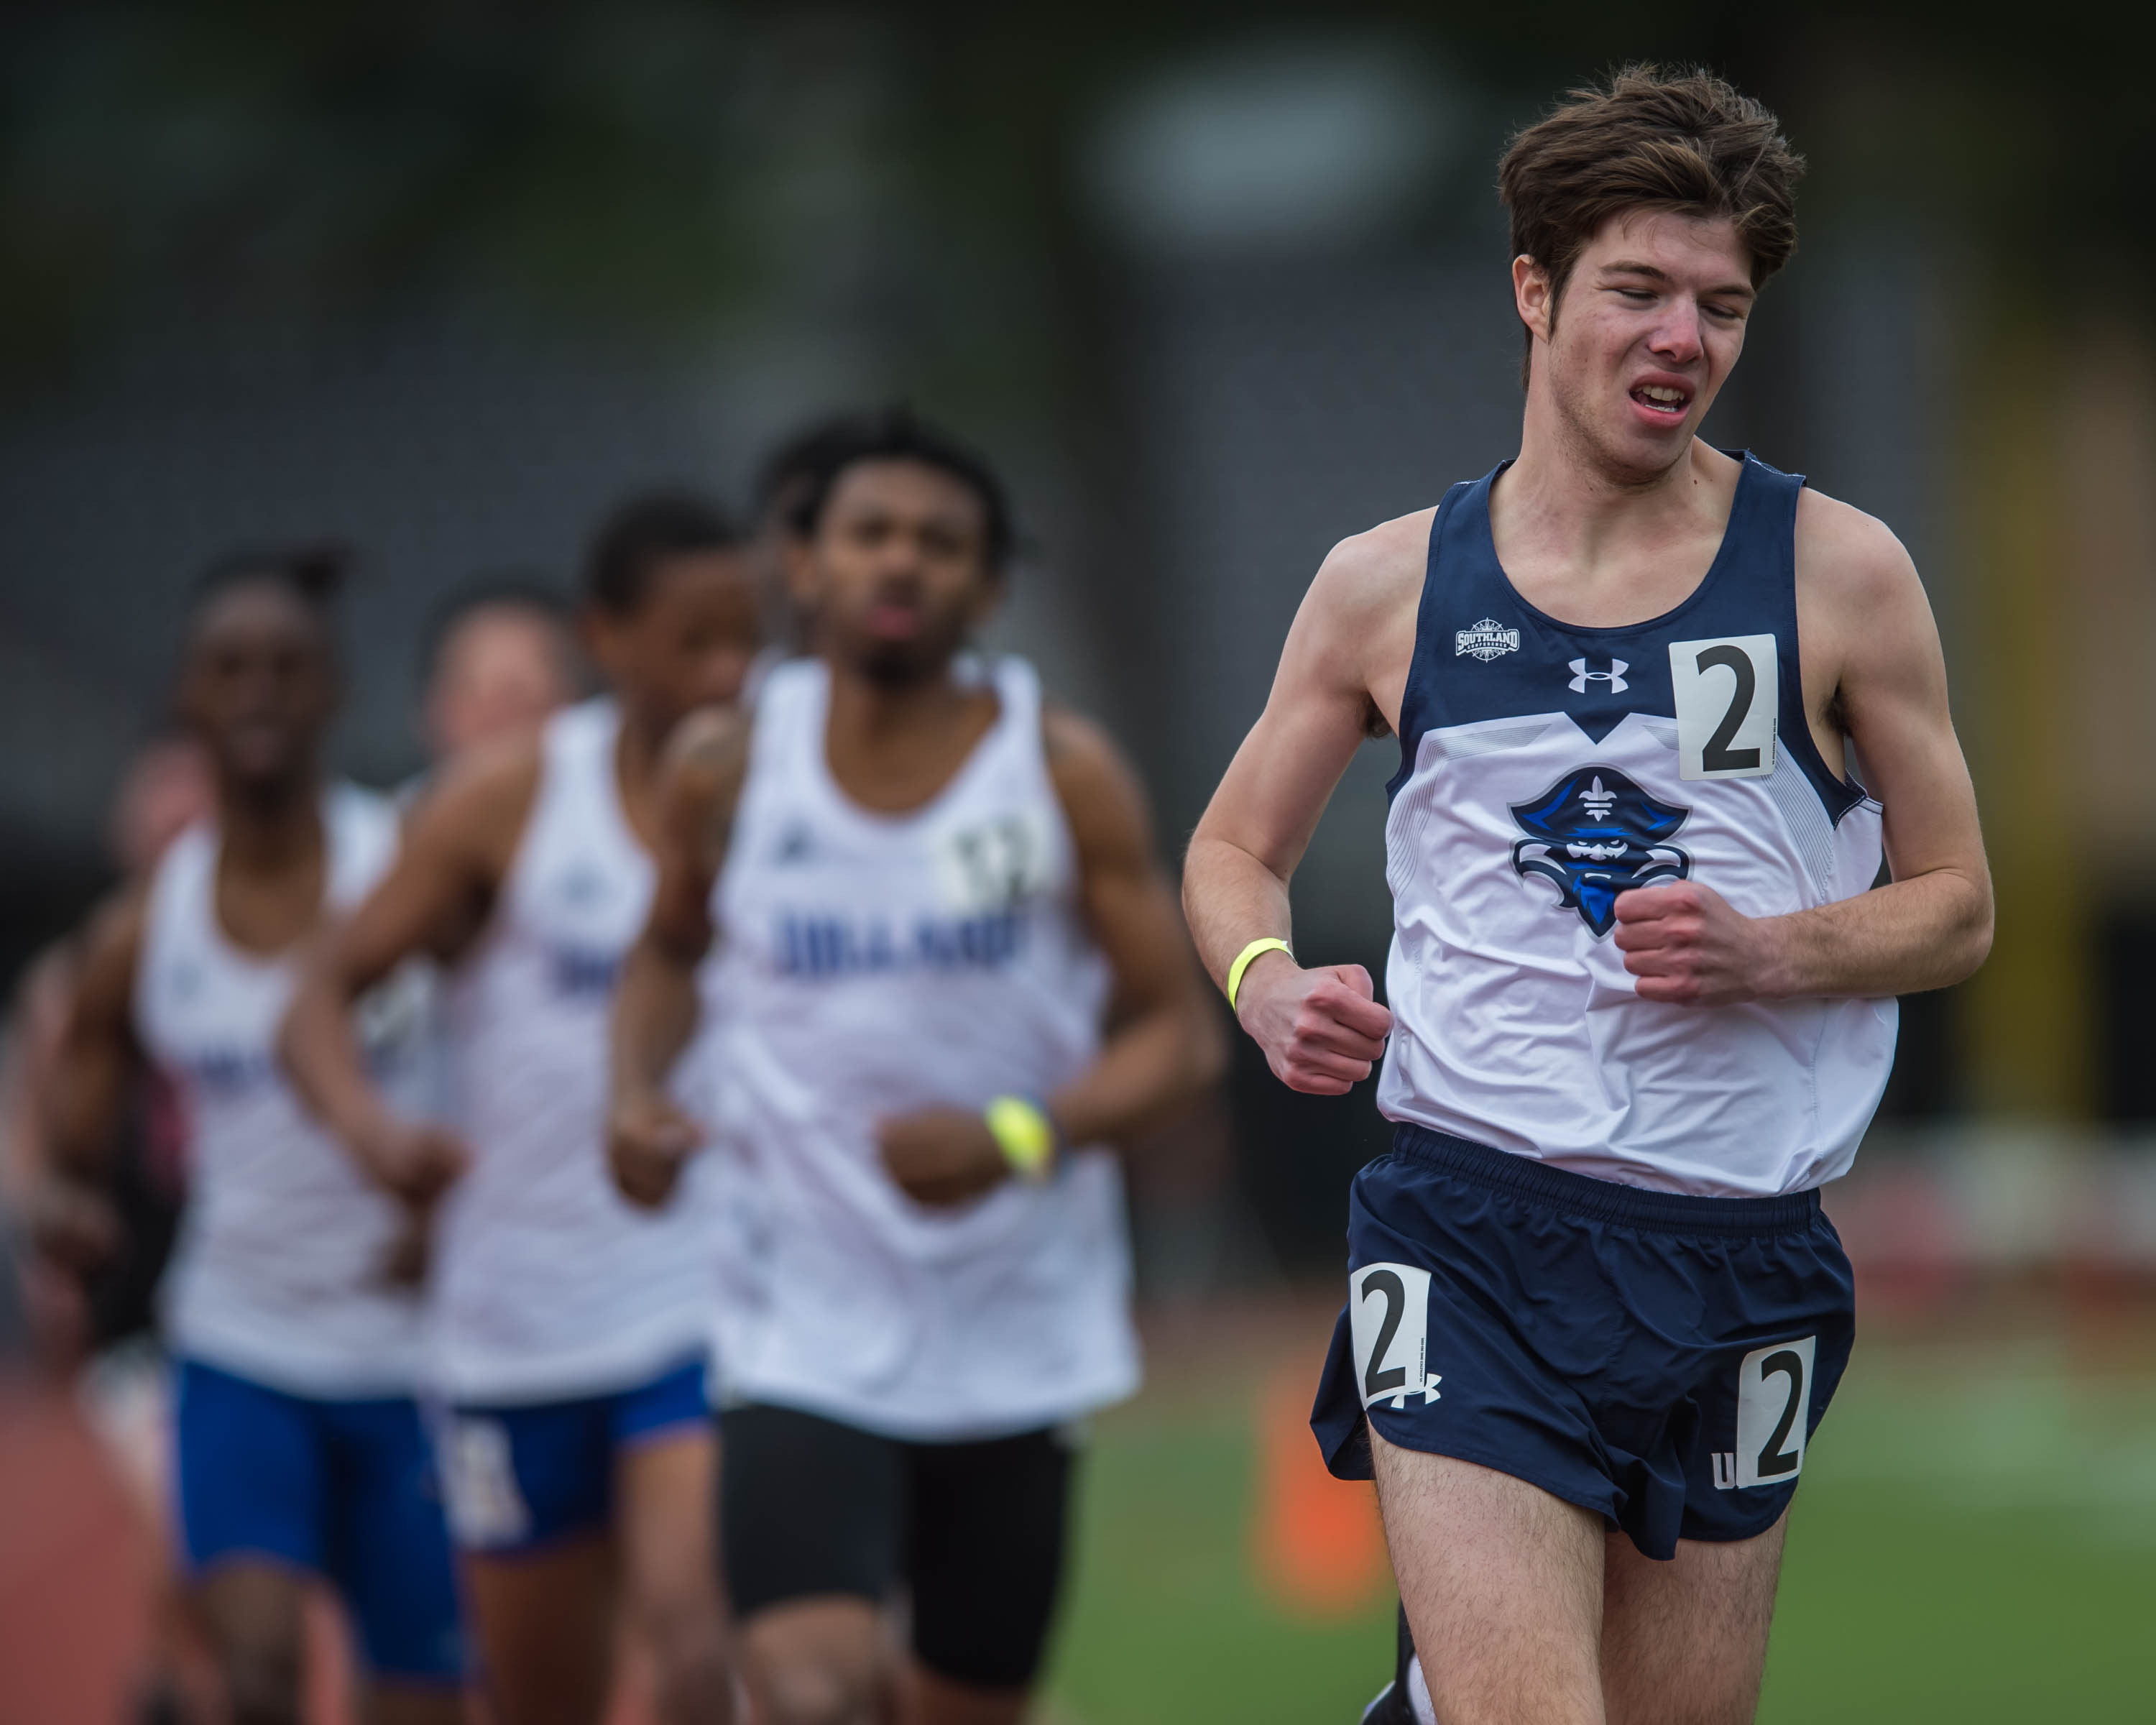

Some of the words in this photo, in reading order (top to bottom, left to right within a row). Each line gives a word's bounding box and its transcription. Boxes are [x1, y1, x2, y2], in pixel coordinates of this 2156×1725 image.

[1457, 631, 1518, 651] SOUTHLAND
[1695, 645, 1760, 772] 2
[1361, 1269, 1406, 1399] 2
[1757, 1350, 1803, 1478] 2
